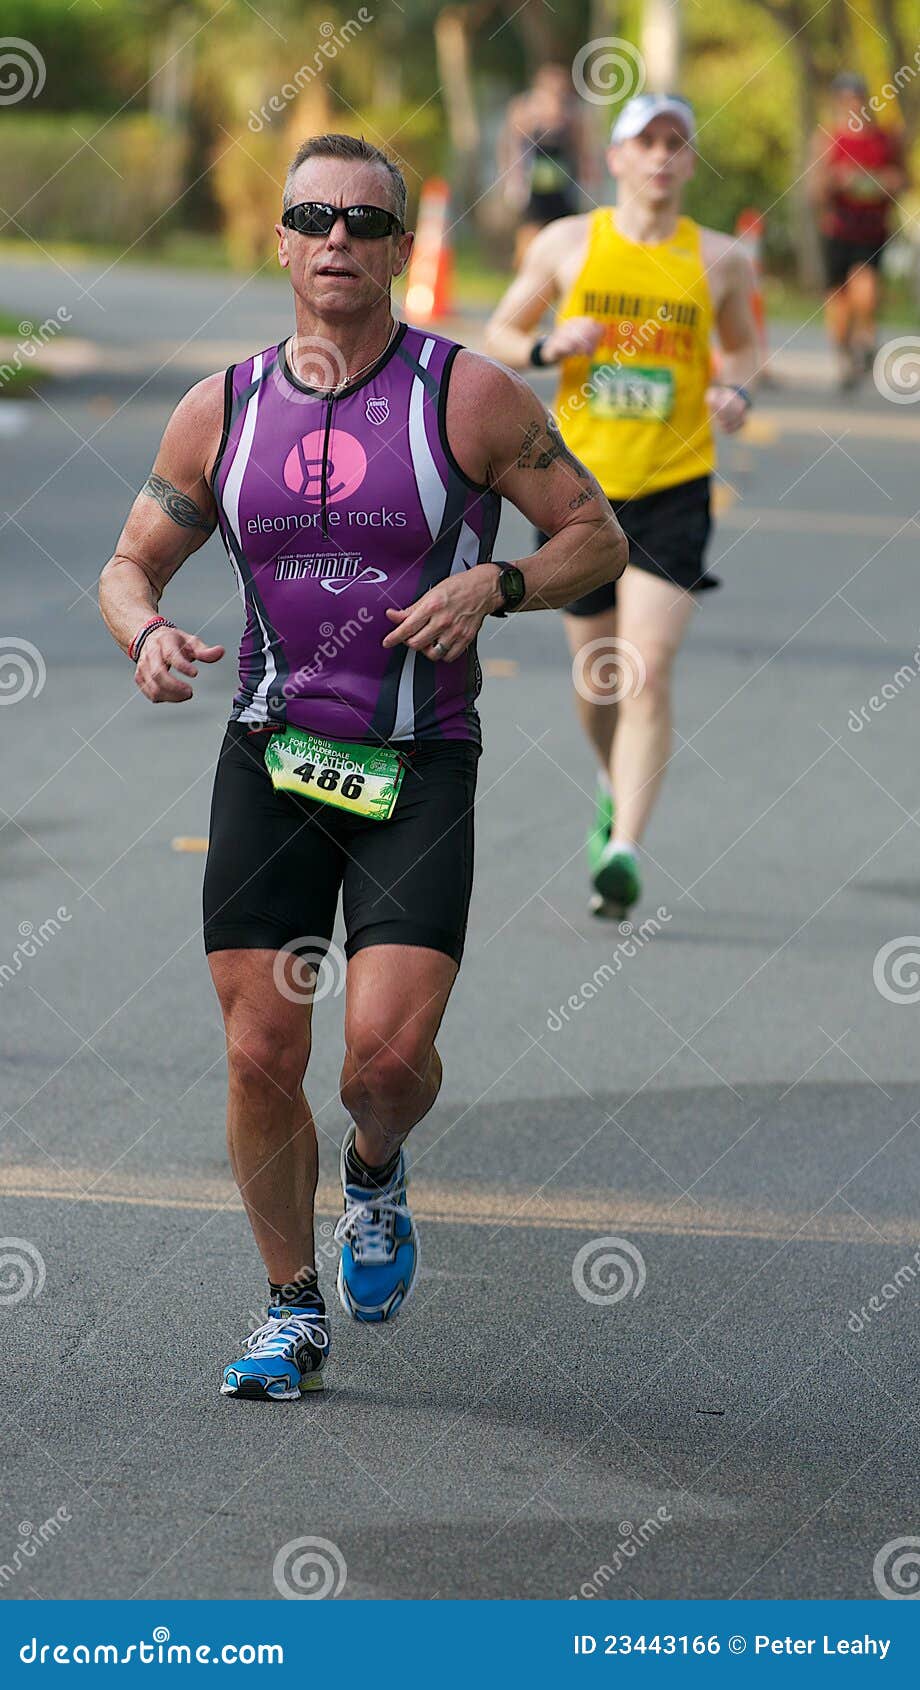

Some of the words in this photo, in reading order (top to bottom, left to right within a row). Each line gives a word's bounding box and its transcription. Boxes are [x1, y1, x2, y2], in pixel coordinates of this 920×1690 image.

[348, 507, 407, 527] rocks
[289, 737, 308, 749] FORT
[307, 743, 350, 760] LAUDERDALE
[295, 748, 365, 774] MARATHON
[293, 762, 365, 800] 486
